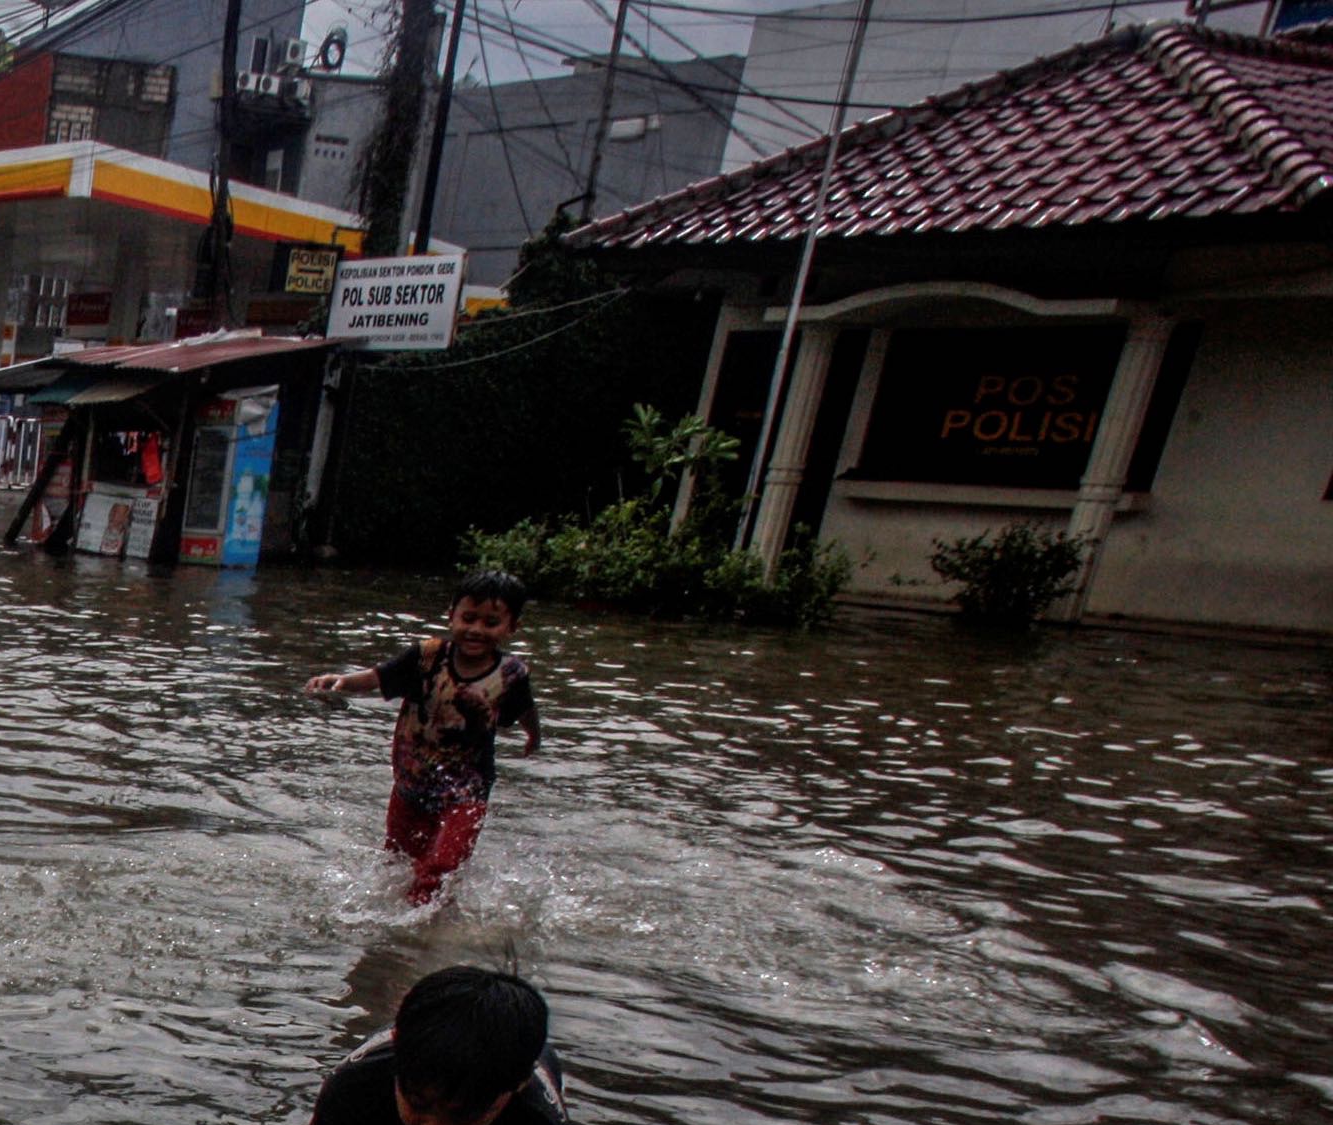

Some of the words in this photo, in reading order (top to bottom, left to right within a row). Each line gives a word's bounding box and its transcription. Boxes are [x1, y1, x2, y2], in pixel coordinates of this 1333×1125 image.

[291, 250, 334, 267] POLISI
[379, 264, 406, 277] SEKTOR
[438, 263, 456, 275] GEDE
[287, 275, 332, 289] POLICE
[341, 287, 364, 307] POL
[367, 285, 392, 306] SUB
[394, 283, 446, 305] SEKTOR
[348, 312, 430, 328] JATIBENING
[973, 374, 1080, 407] POS
[939, 408, 1100, 445] POLISI
